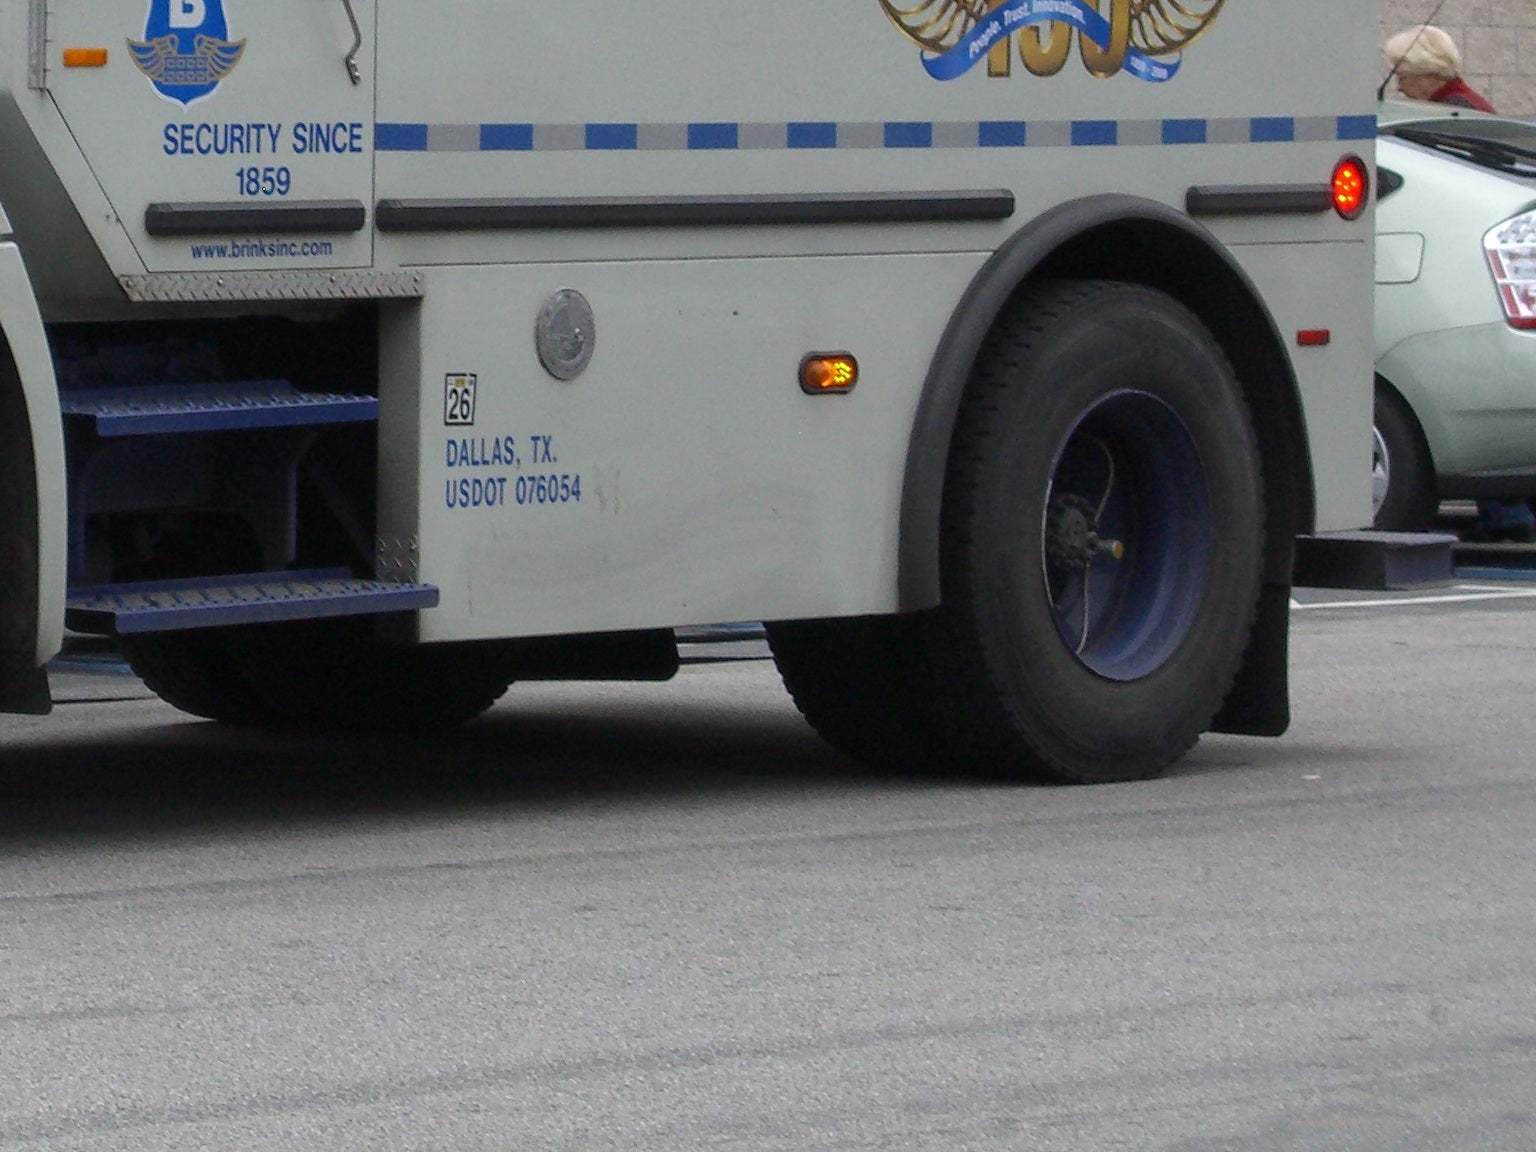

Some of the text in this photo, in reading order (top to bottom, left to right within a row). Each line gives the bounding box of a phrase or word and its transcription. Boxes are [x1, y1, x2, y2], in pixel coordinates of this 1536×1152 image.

[163, 122, 362, 155] SECURITY SINCE
[235, 166, 291, 196] 1859
[191, 239, 332, 259] www.brinksinc.com
[449, 388, 470, 420] 26
[446, 435, 557, 468] DALLAS, TX.
[445, 474, 581, 508] USDOT 076054
